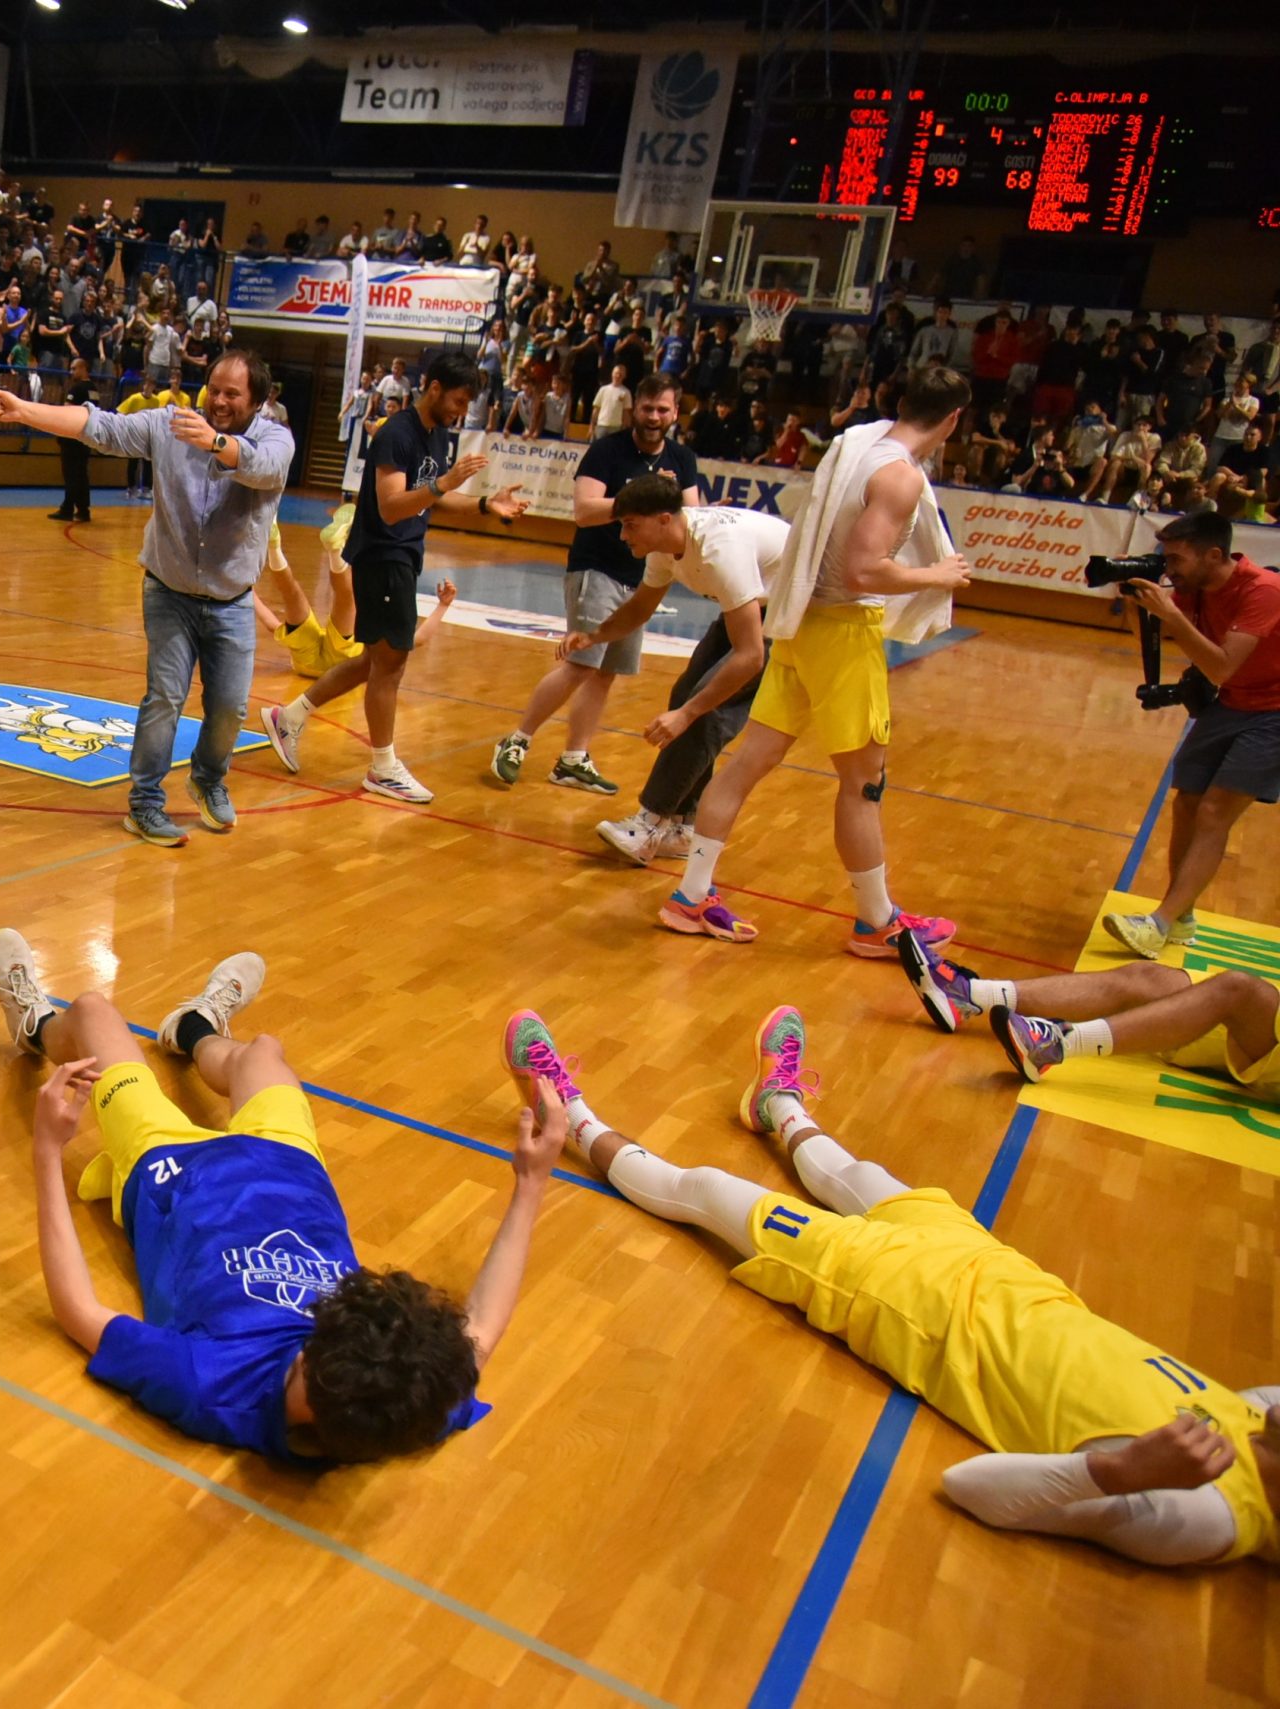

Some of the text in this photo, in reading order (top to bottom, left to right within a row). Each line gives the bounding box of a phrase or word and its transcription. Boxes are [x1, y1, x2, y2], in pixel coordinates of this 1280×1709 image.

[354, 79, 440, 110] Team
[1055, 92, 1133, 103] C.OLIMPIJA
[1048, 124, 1110, 134] KARADZIC
[1051, 113, 1119, 124] TODOROVIC
[990, 126, 1003, 145] 4
[1046, 134, 1085, 144] LICAN
[636, 131, 709, 167] KZS
[1004, 155, 1036, 168] GOSTI
[1040, 163, 1086, 173] HORVAT
[934, 167, 1032, 190] 99 68
[1035, 182, 1090, 193] KOZOROG
[296, 274, 413, 309] ŠTEMHAR
[529, 447, 579, 462] PUHAR
[696, 472, 786, 516] NEX
[963, 505, 1084, 529] gorenjska
[964, 531, 1082, 556] gradbena
[974, 552, 1057, 578] družba
[147, 1156, 183, 1185] 12
[762, 1205, 811, 1239] 11
[1143, 1355, 1207, 1395] 11
